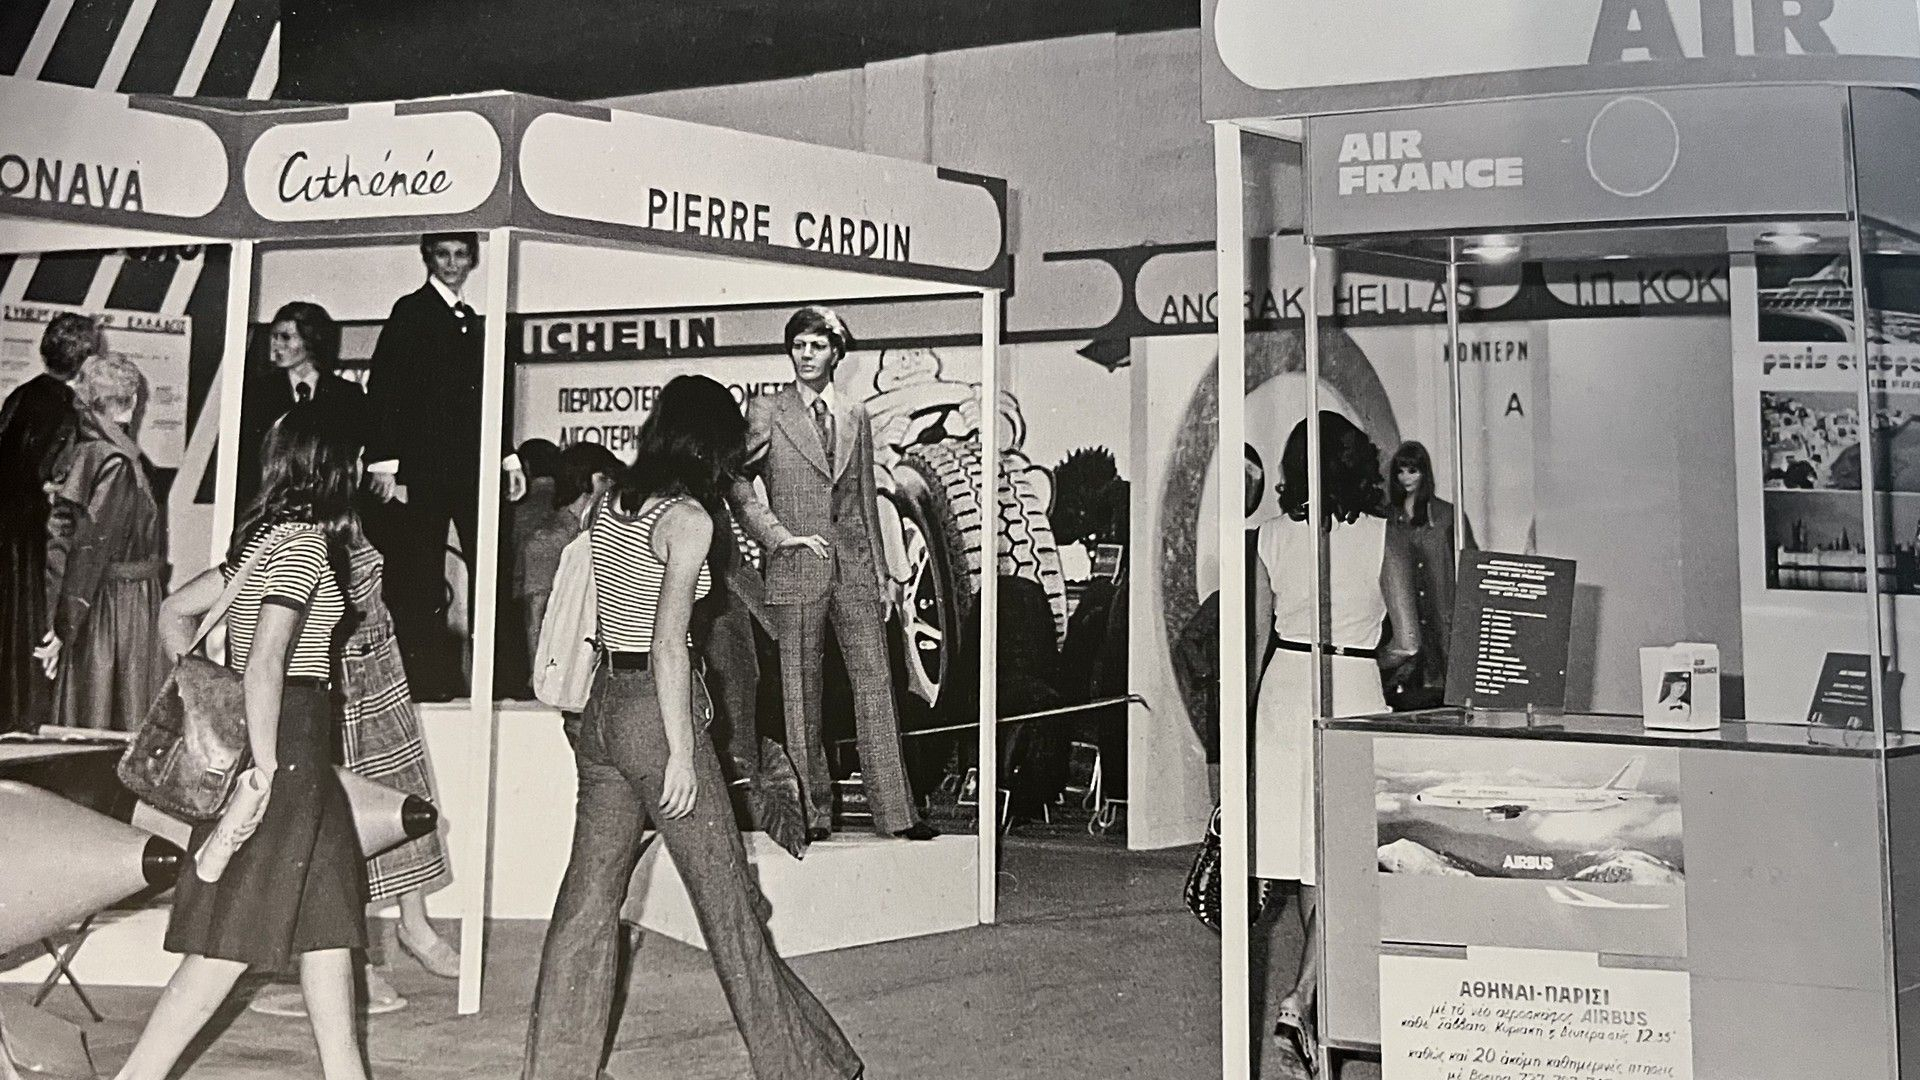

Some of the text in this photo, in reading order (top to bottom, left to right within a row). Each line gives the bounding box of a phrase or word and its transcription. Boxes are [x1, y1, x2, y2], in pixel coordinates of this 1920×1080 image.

[1588, 0, 1841, 64] AIR
[1338, 130, 1422, 163] AIR
[0, 154, 144, 212] ONAVA
[1338, 157, 1524, 196] FRANCE
[648, 187, 911, 262] PIERRE CARDIN
[1333, 278, 1475, 316] HELLAS
[531, 317, 717, 353] ICHELIN
[1763, 346, 1828, 375] paris
[1503, 854, 1554, 871] AIRBUS
[1581, 1009, 1648, 1026] AIRBUS
[1473, 1047, 1496, 1063] 20
